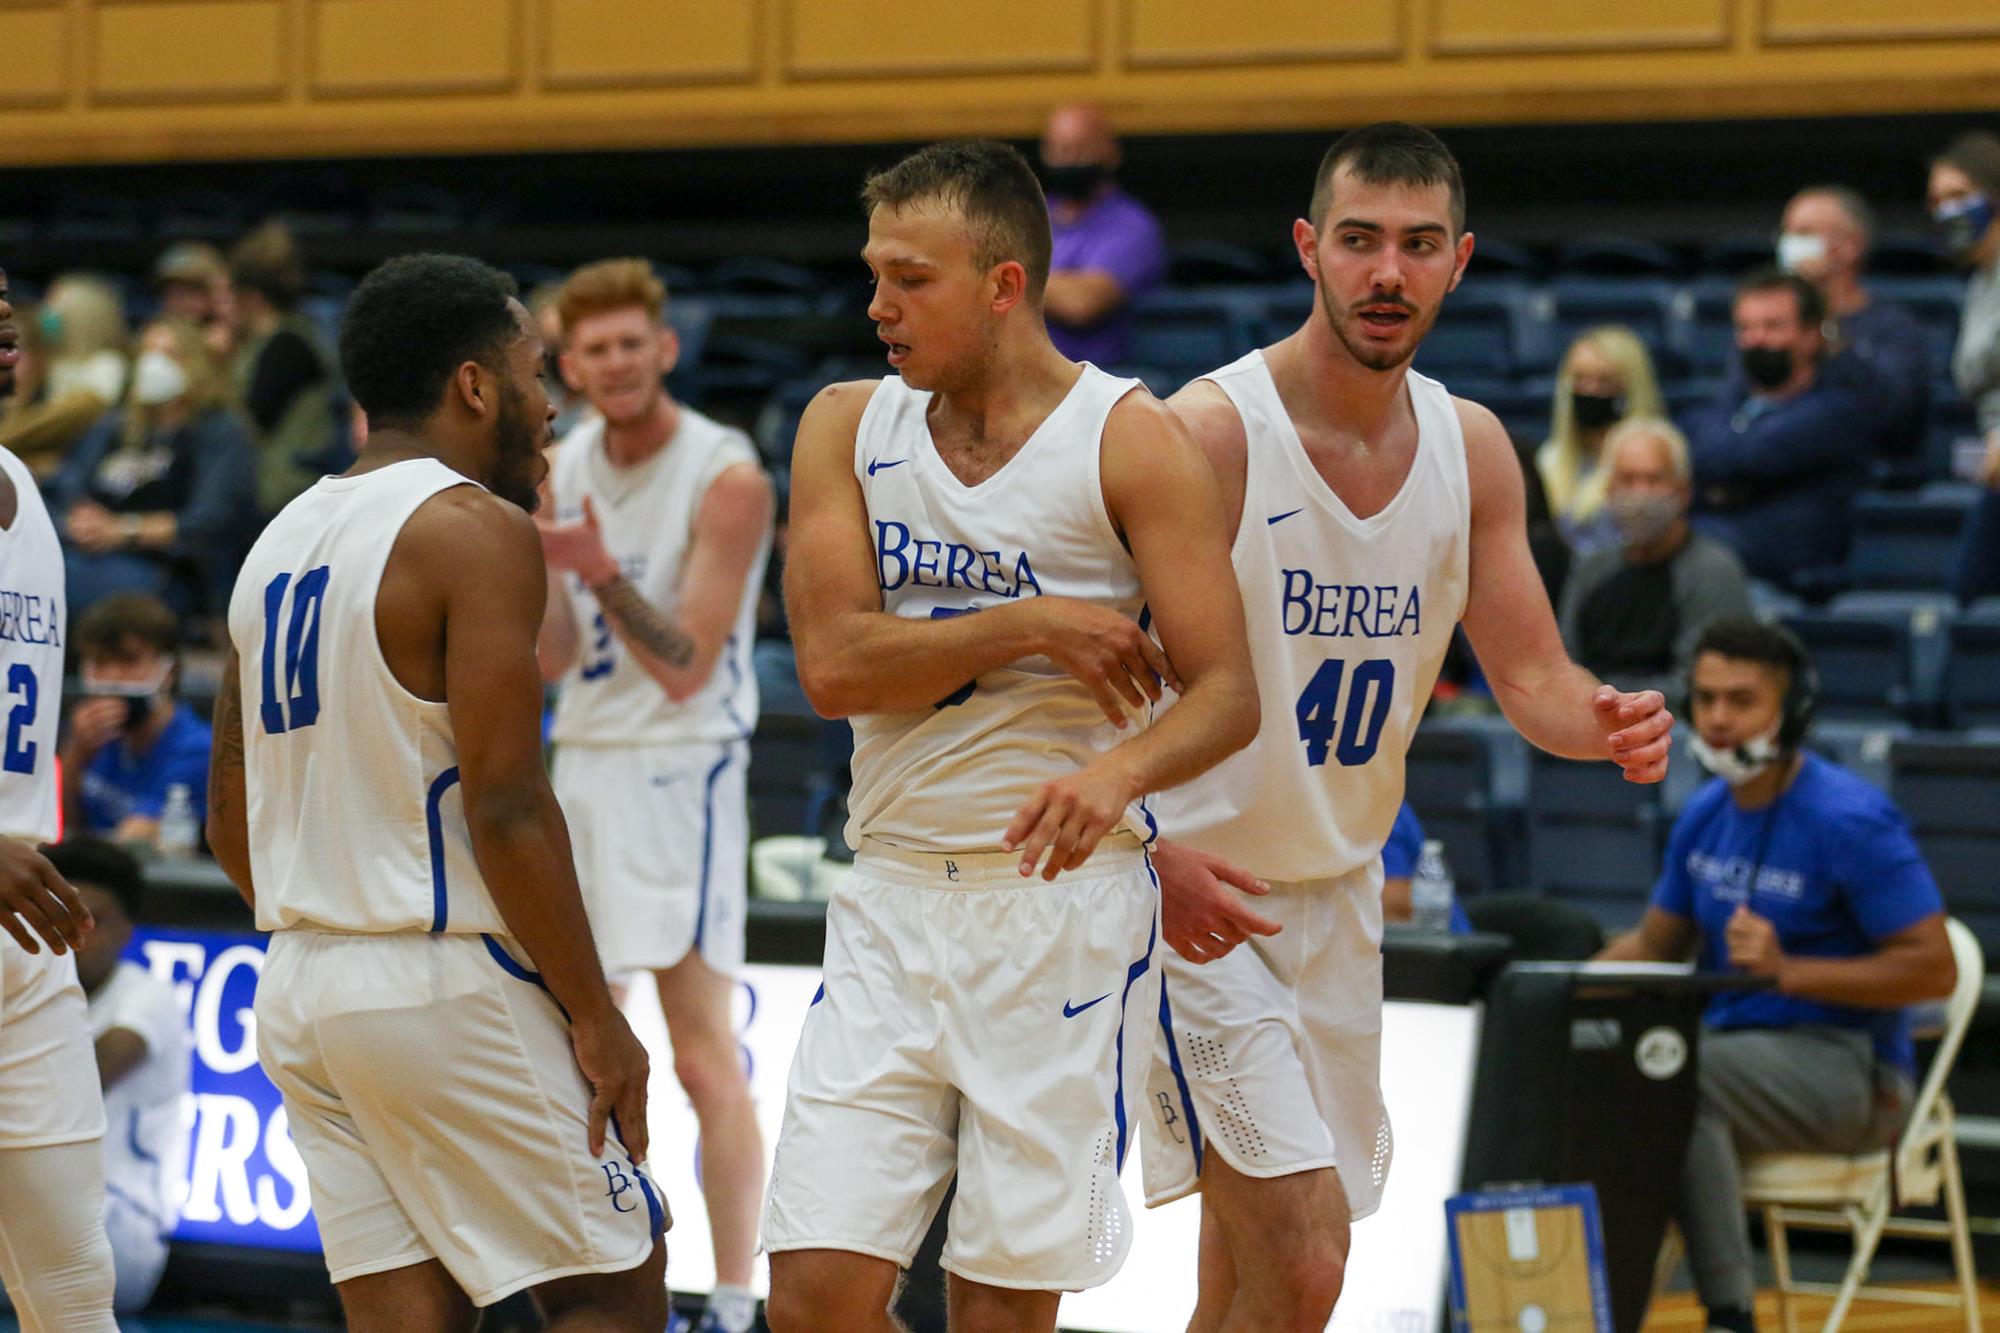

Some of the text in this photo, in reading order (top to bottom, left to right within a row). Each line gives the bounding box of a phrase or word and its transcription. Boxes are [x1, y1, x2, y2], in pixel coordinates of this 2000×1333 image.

[875, 519, 1042, 598] BEREA
[1281, 568, 1420, 638] BEREA
[260, 565, 330, 735] 10
[3, 663, 38, 774] 2
[1296, 658, 1395, 767] 40
